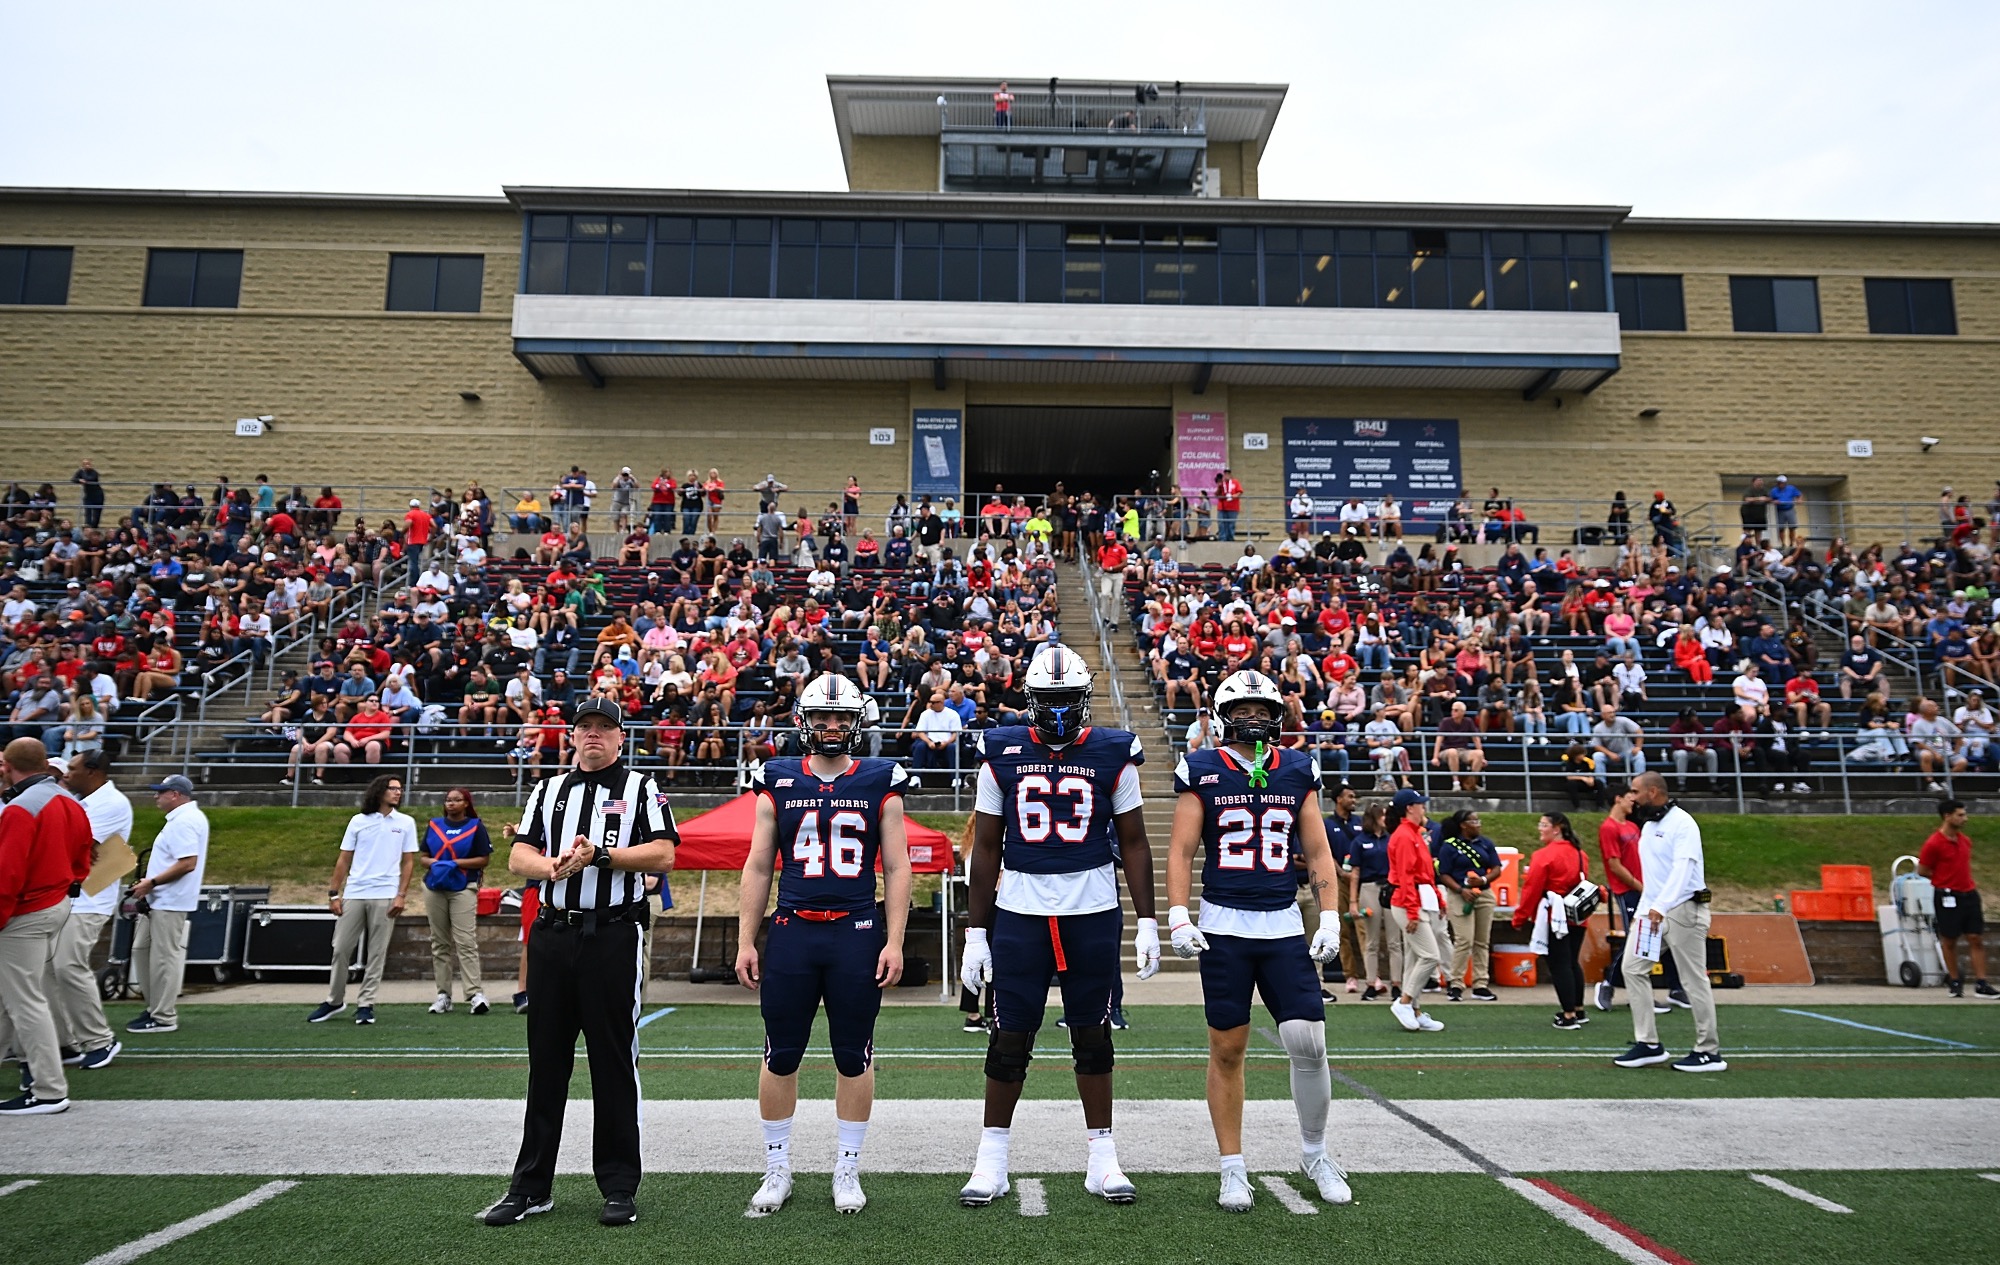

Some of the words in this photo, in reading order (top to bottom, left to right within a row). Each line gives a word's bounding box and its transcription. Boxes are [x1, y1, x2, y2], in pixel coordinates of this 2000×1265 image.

[241, 424, 257, 432] 102
[1354, 420, 1387, 434] RMU
[1178, 462, 1226, 470] CHAMPIONS
[1016, 764, 1054, 774] ROBERT
[1058, 765, 1096, 777] MORRIS
[785, 799, 824, 809] ROBERT
[830, 799, 869, 809] MORRIS
[1214, 795, 1254, 805] ROBERT
[1260, 795, 1296, 805] MORRIS
[555, 801, 565, 812] S
[1015, 774, 1094, 842] 63
[605, 830, 618, 846] S
[793, 810, 868, 878] 46
[1217, 806, 1294, 872] 28
[855, 920, 873, 930] RMU
